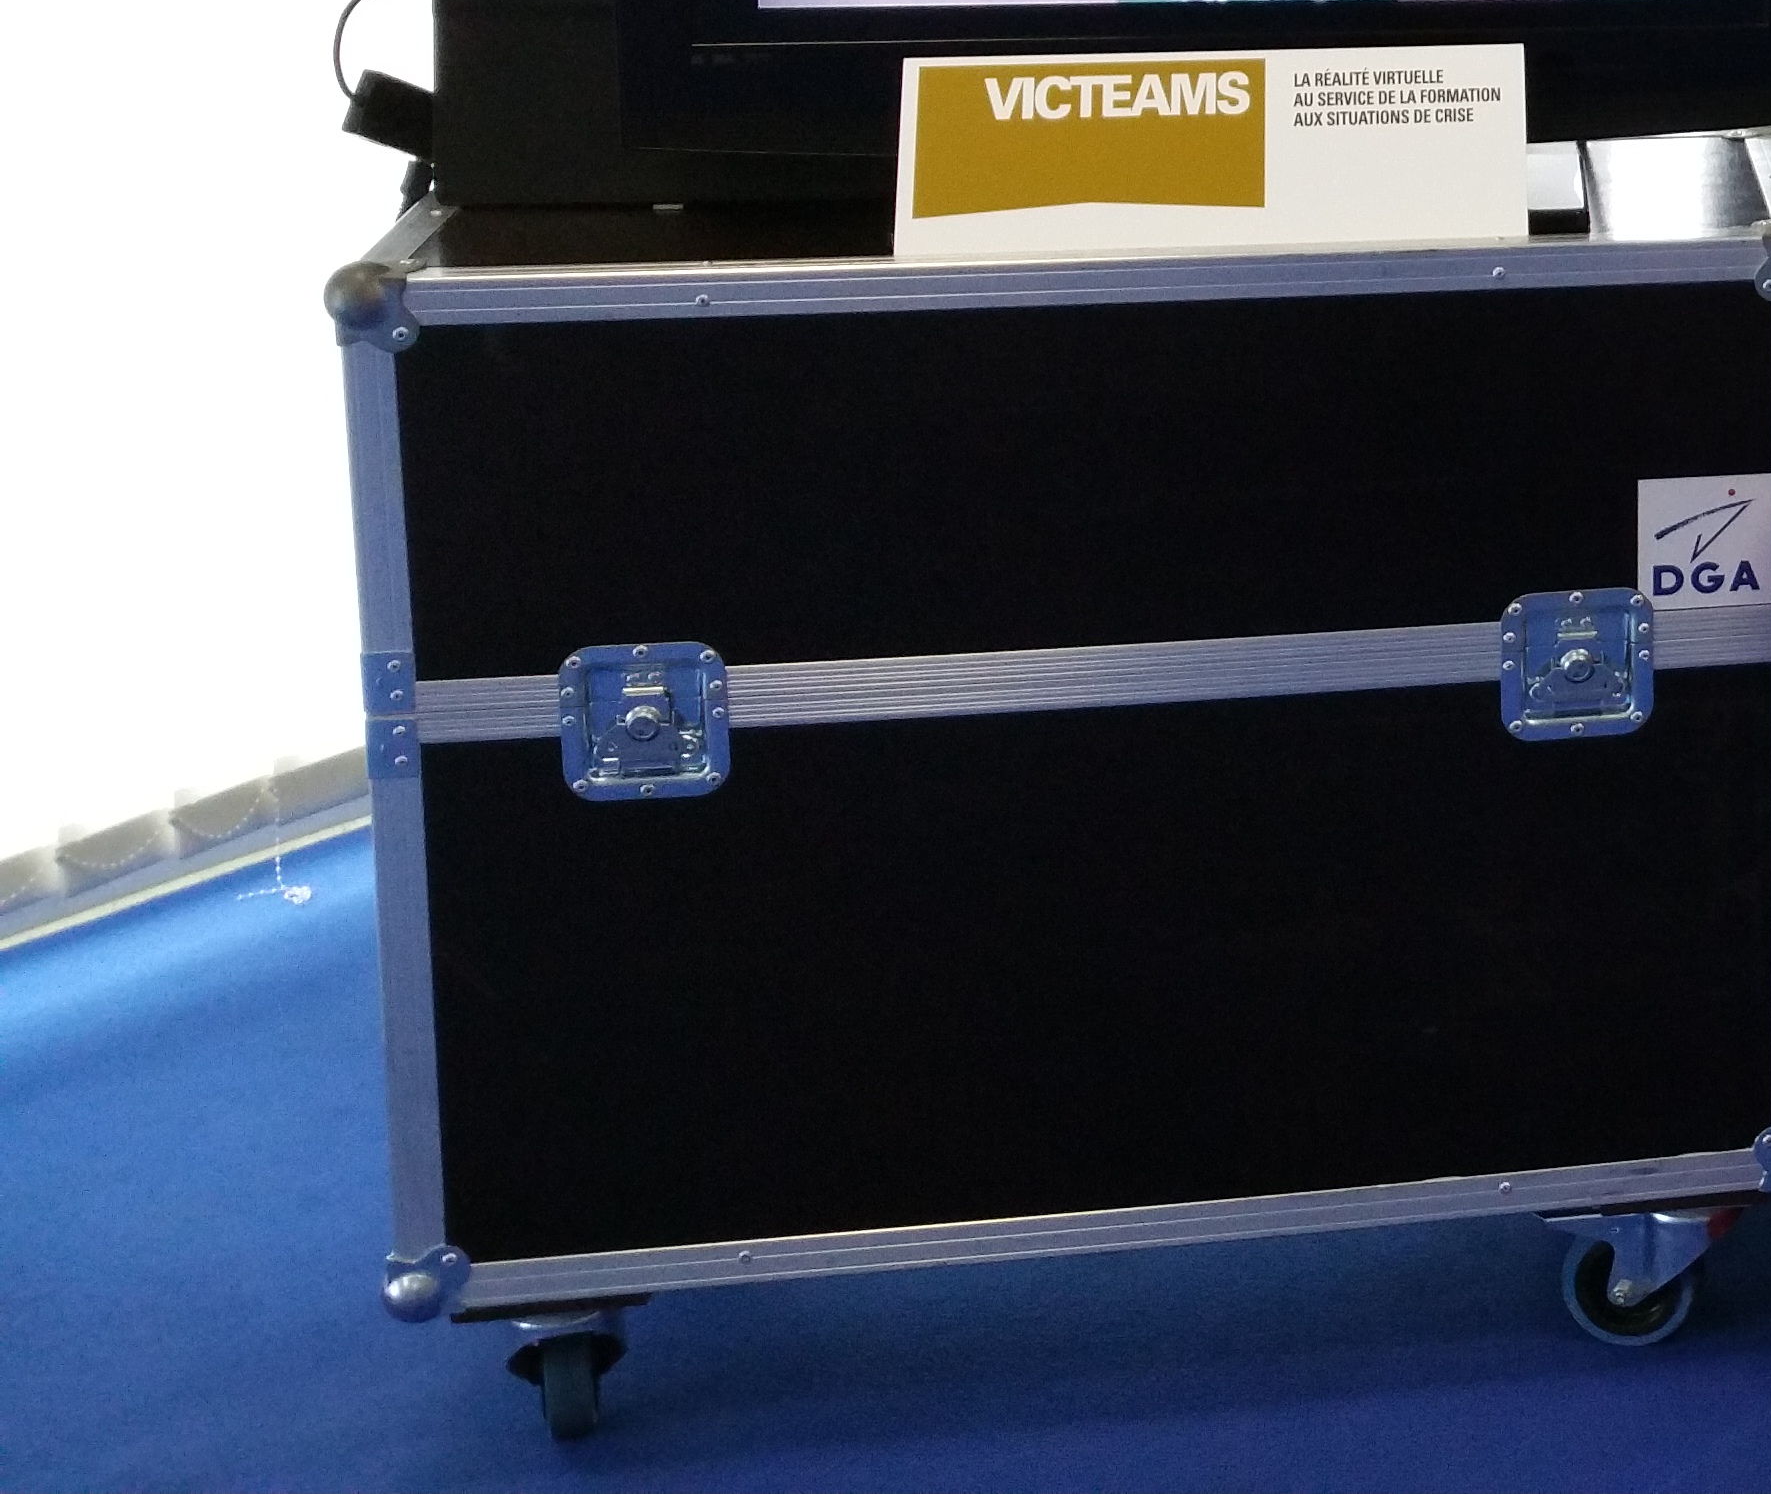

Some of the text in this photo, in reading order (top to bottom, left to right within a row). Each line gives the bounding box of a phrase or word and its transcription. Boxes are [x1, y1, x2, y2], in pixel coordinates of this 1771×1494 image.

[1294, 70, 1443, 87] LA RÉALITÉ VIRTUELLE
[985, 71, 1250, 120] VICTEAMS
[1294, 88, 1500, 107] AU SERVICE DE LA FORMATION
[1294, 108, 1473, 126] AUX SITUATIONS DE CRISE
[1653, 561, 1760, 596] DGA
